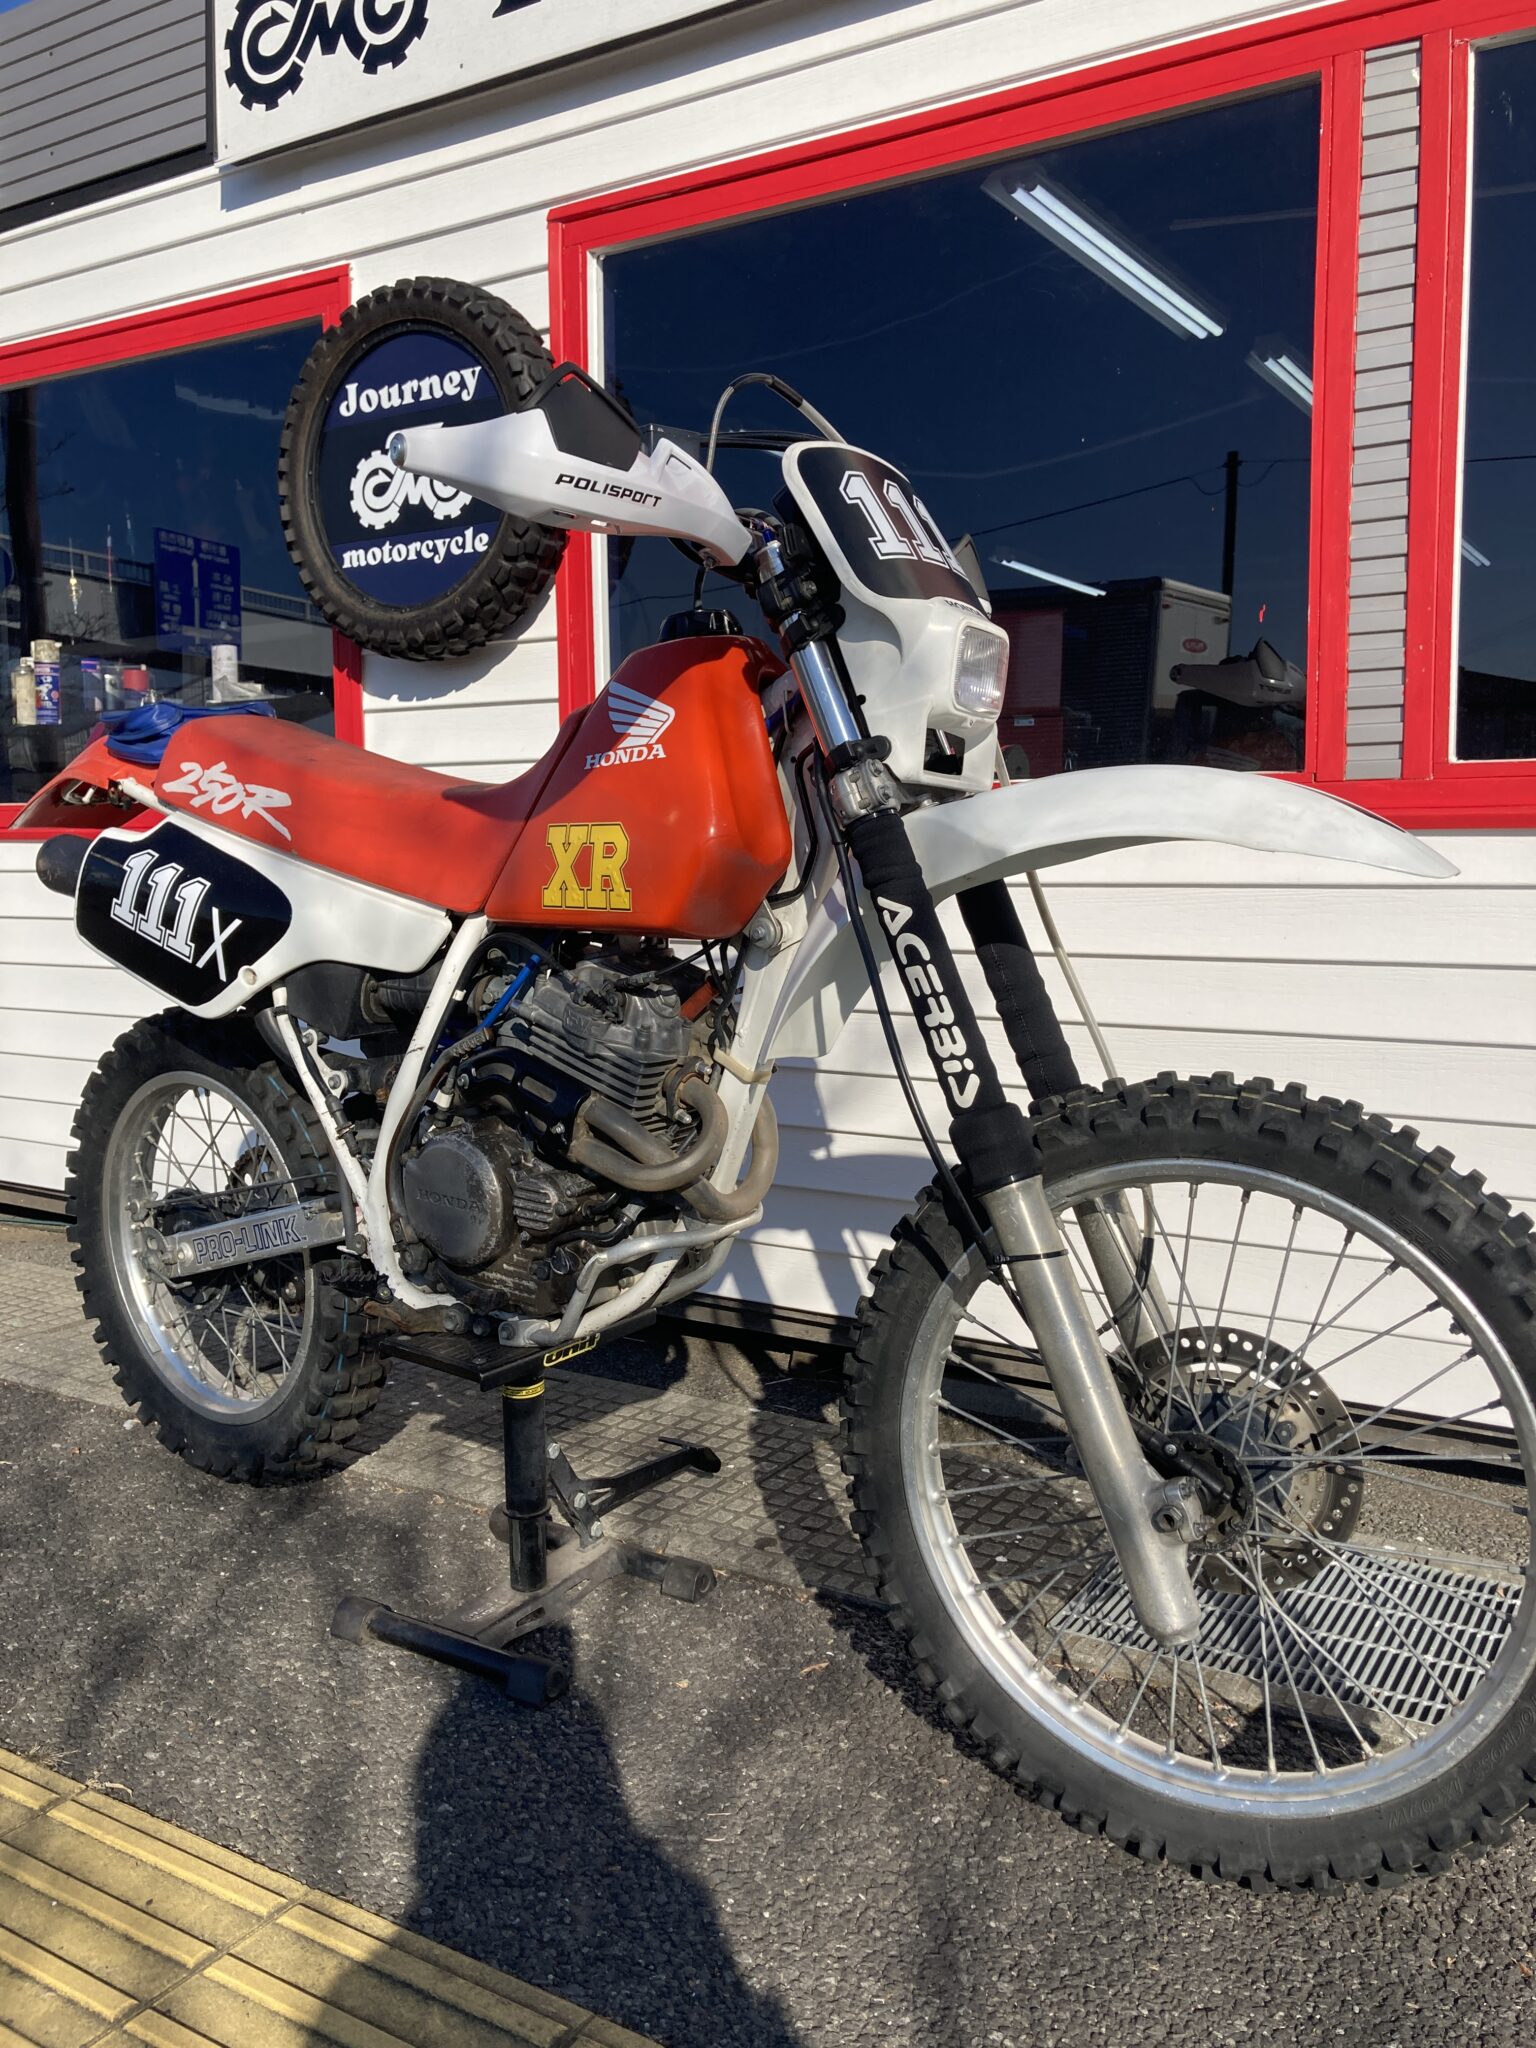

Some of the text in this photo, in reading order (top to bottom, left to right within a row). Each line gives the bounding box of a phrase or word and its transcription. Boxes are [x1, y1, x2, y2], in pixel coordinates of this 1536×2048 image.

[339, 366, 482, 418] Journey
[555, 473, 663, 509] POLISPORT
[342, 526, 490, 570] motorcycle
[838, 470, 970, 582] 111
[584, 743, 667, 770] HONDA
[162, 760, 292, 842] 250R
[541, 821, 633, 913] XR
[192, 1214, 303, 1265] PRO-LINK
